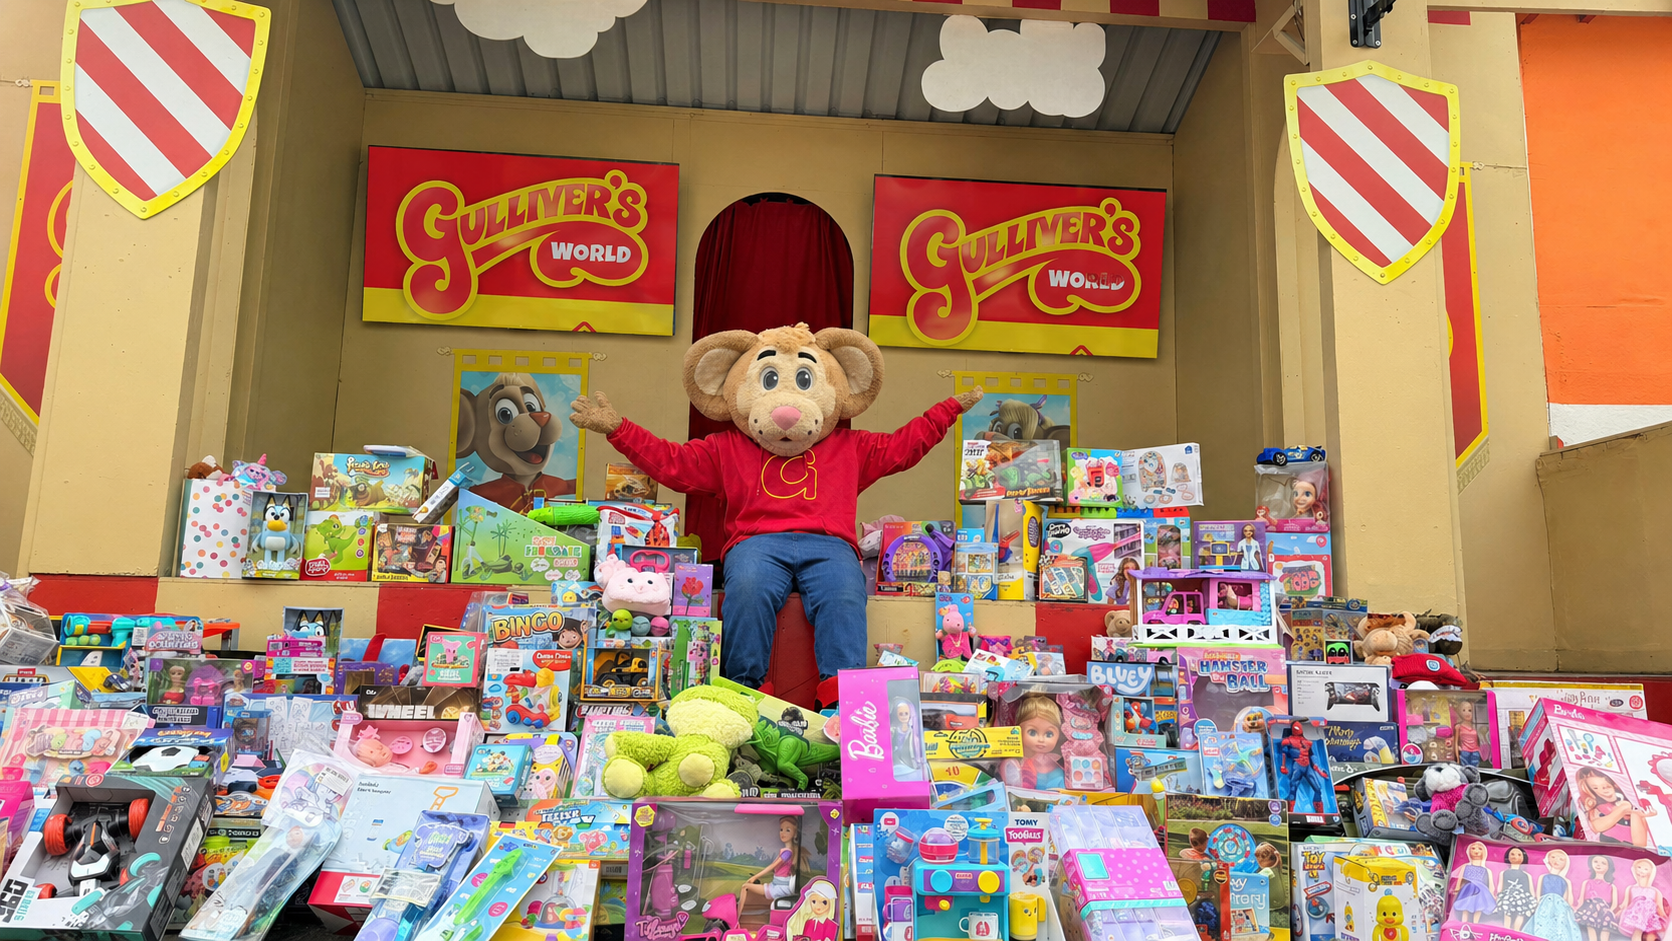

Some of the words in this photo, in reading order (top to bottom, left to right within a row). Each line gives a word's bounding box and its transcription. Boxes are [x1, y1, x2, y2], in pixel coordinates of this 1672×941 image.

[398, 171, 646, 319] GULLIVER'S
[550, 241, 632, 263] WORLD
[902, 198, 1139, 345] GULLIVER'S
[492, 610, 565, 642] BINGO
[1090, 664, 1152, 694] BLUEY
[1199, 659, 1268, 674] HAMSTER
[1226, 673, 1270, 692] BALL
[1014, 818, 1039, 826] TOMY
